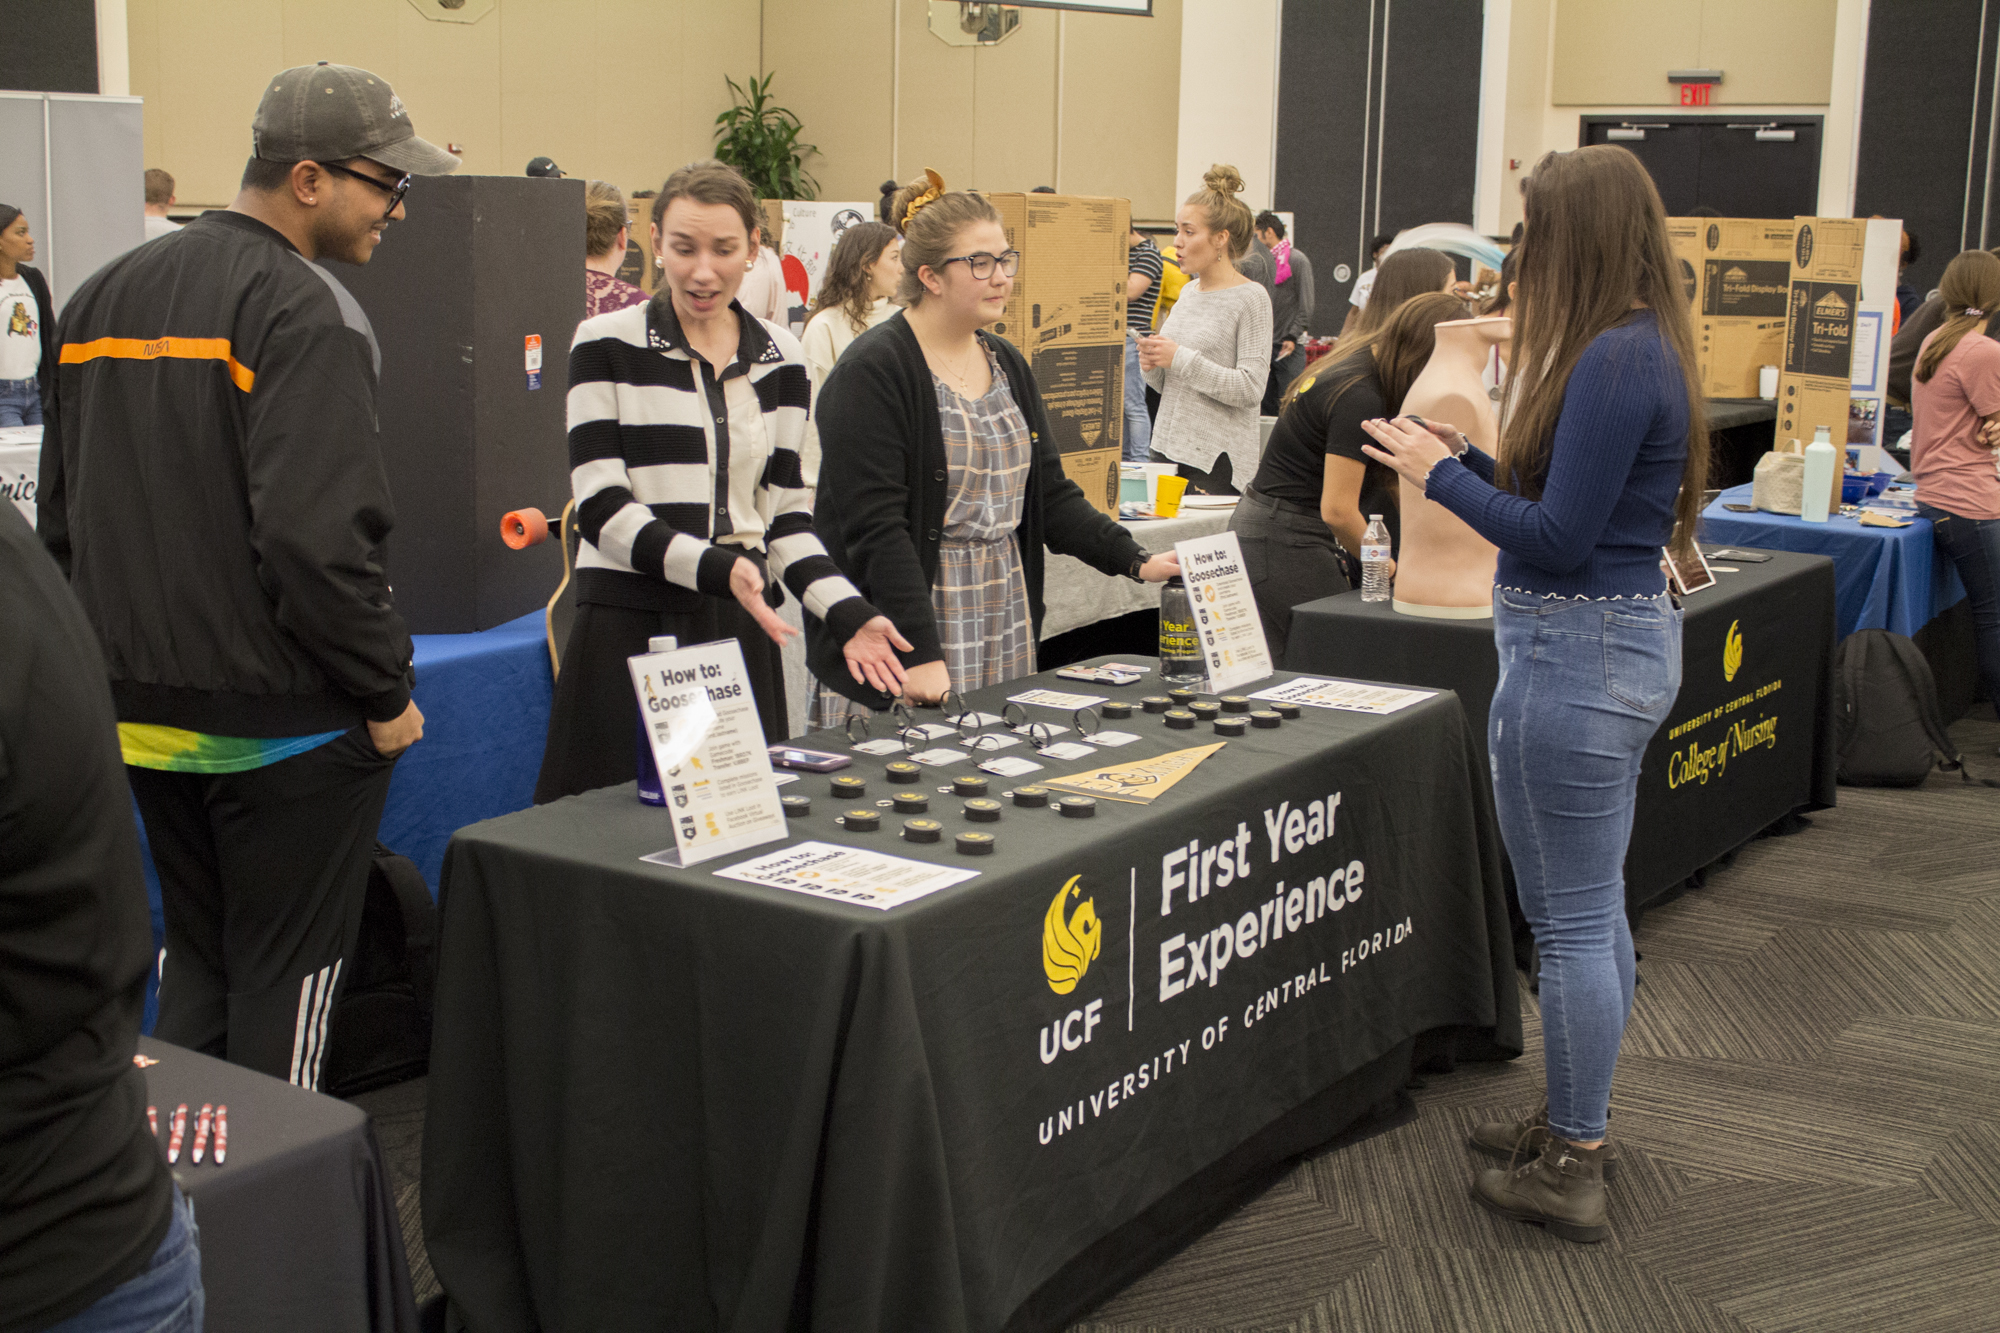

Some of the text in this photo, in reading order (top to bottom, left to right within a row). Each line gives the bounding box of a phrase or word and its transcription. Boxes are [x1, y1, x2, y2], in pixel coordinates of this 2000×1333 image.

[1681, 83, 1712, 106] EXIT
[792, 207, 817, 218] Culture
[1812, 321, 1849, 337] Tri-Fold
[143, 340, 169, 356] NASA
[1193, 549, 1228, 566] How to:
[1162, 620, 1190, 633] Year
[660, 663, 722, 687] How to:
[648, 682, 742, 713] Goosehase
[1668, 679, 1782, 741] UNIVERSITY OF CENTRAL FLORIDA
[1668, 713, 1778, 790] College of Nursing
[754, 858, 793, 871] How
[1160, 791, 1342, 916] First Year
[1158, 859, 1365, 1003] Experience
[1038, 916, 1413, 1146] UNIVERSITY OF CENTRAL FLORIDA
[1039, 998, 1103, 1065] UCF
